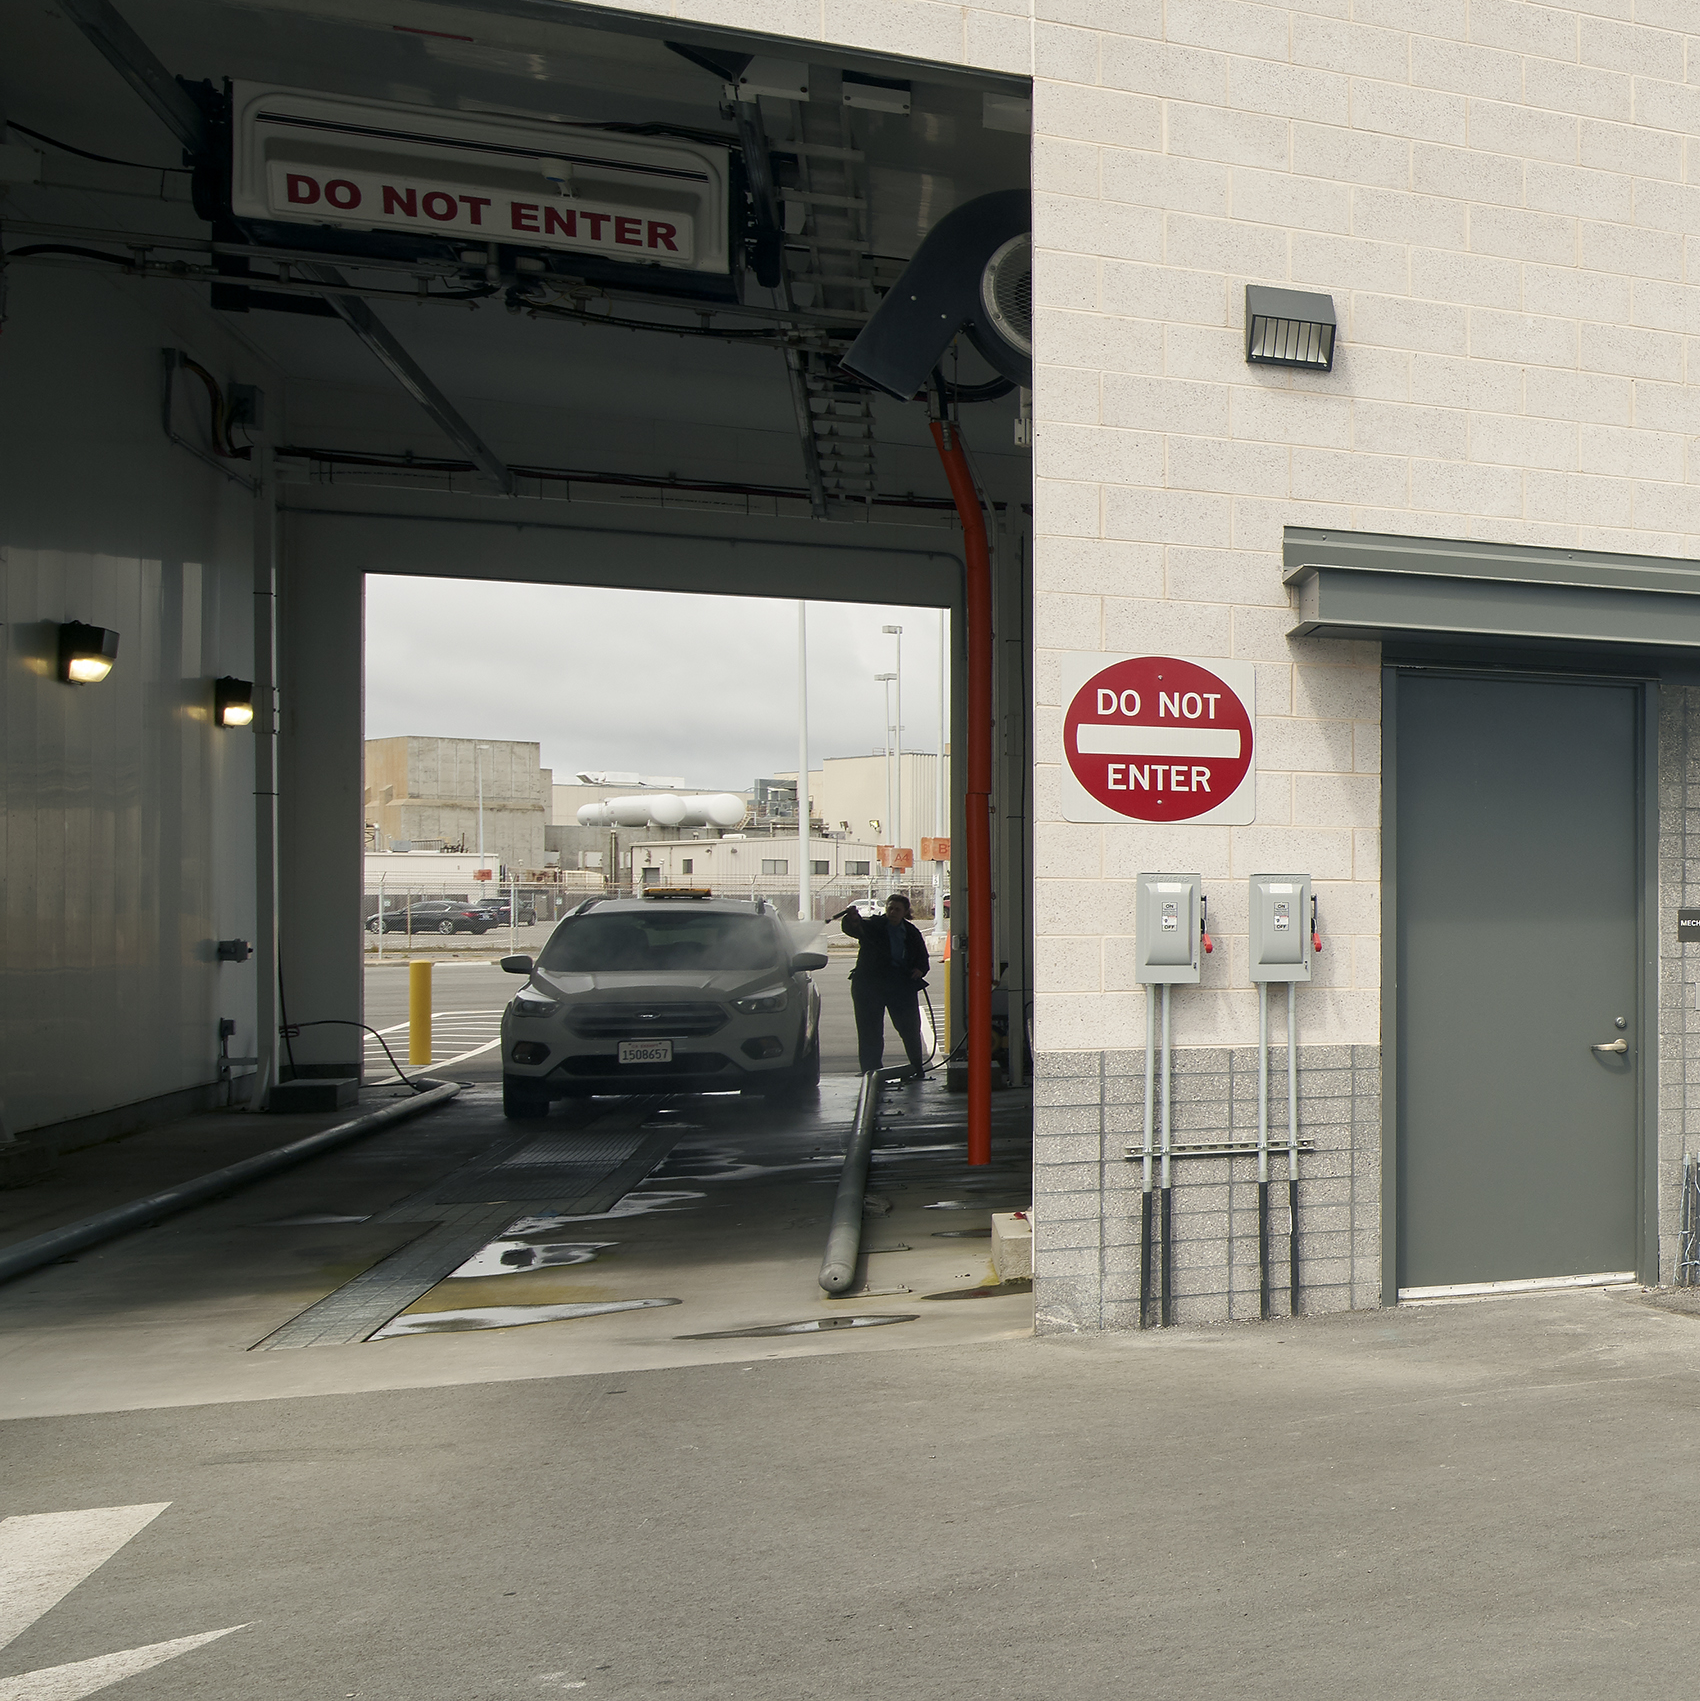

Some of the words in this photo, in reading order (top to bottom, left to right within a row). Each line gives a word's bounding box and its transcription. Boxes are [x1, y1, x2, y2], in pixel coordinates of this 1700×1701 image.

[286, 173, 362, 210] DO
[382, 184, 492, 226] NOT
[511, 201, 680, 252] ENTER
[1097, 688, 1141, 717] DO
[1158, 691, 1221, 719] NOT
[1108, 764, 1211, 792] ENTER
[623, 1049, 668, 1060] 1508657
